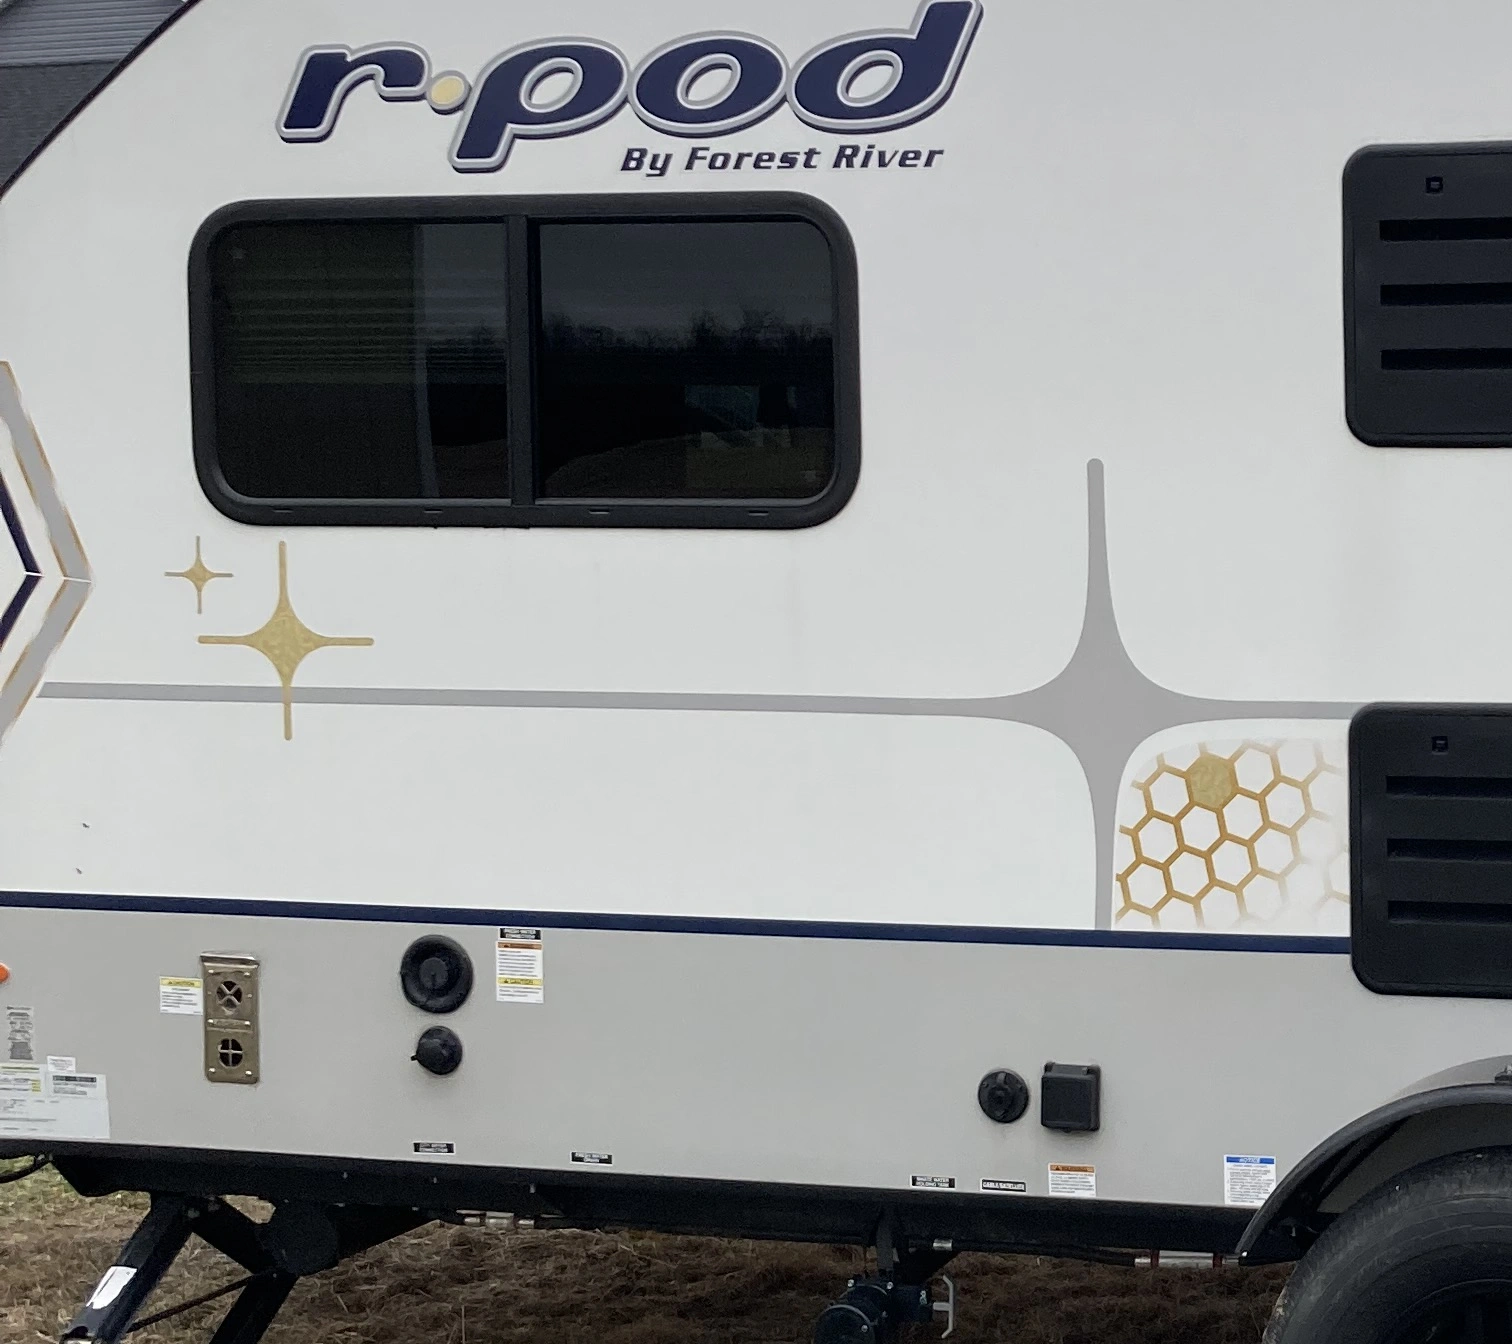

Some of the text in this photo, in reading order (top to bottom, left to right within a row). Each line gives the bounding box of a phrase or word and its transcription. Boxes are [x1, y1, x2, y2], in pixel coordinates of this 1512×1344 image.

[620, 143, 945, 178] By Forest River
